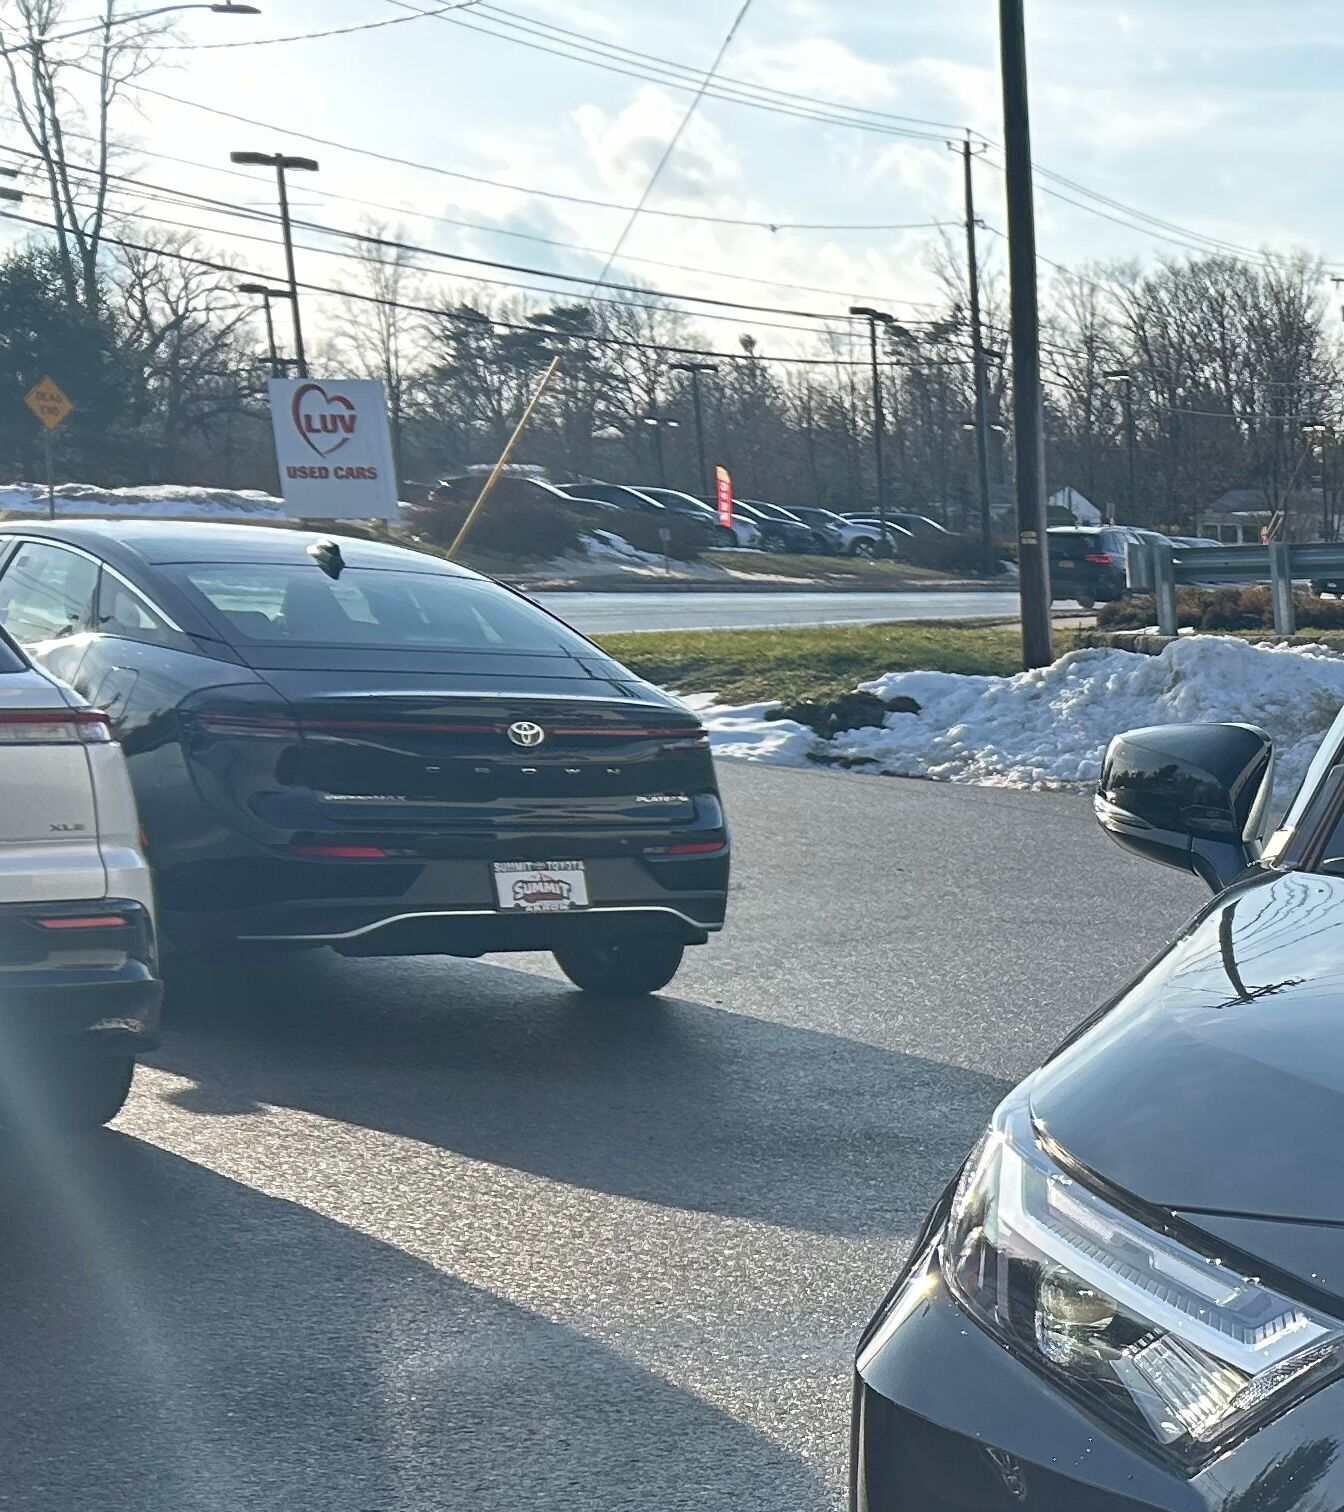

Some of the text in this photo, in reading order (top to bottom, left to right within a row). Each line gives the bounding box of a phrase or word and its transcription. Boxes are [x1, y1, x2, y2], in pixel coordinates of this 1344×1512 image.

[35, 391, 62, 403] DEAD
[40, 405, 60, 416] END
[303, 414, 357, 433] LUV
[286, 466, 377, 480] USED CARS
[49, 823, 84, 832] XLE
[494, 860, 585, 873] SUMMIT TOYOTA
[513, 880, 571, 900] SUMMIT
